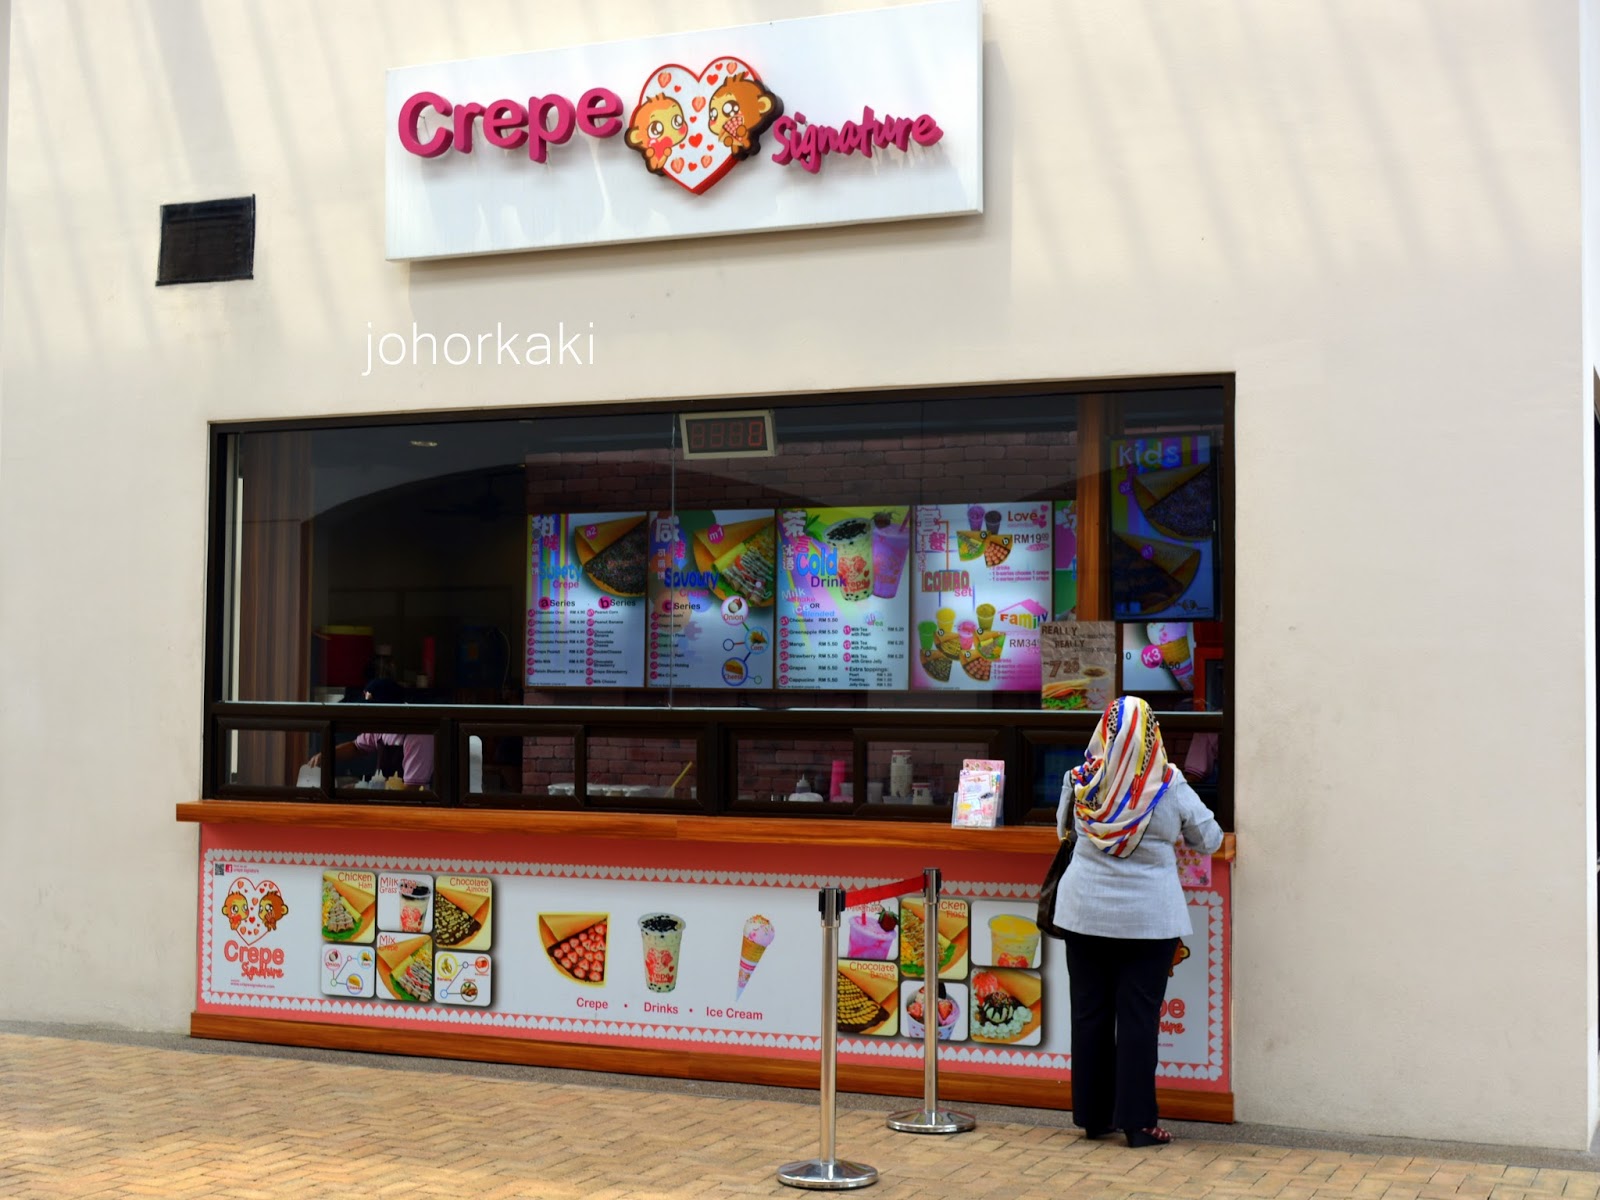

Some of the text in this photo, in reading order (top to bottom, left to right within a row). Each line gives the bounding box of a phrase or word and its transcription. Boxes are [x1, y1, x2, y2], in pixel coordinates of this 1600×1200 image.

[398, 87, 944, 174] Crepe Signature
[1008, 510, 1037, 522] Love
[797, 548, 838, 577] Cold
[664, 567, 720, 590] Savoury
[811, 576, 847, 588] Drink
[553, 580, 580, 589] Crepe
[954, 586, 975, 597] set
[550, 600, 576, 608] Series
[611, 599, 636, 607] Series
[674, 602, 701, 611] Series
[723, 613, 744, 621] Onion
[802, 608, 835, 618] Blended
[1041, 625, 1078, 637] REALLY
[1054, 639, 1085, 649] REALLY
[1143, 647, 1161, 665] K3
[338, 872, 372, 882] Chicken
[450, 877, 489, 887] Chocolate
[380, 878, 416, 888] Milk Tea
[938, 901, 966, 910] icken
[380, 936, 396, 946] Mix
[224, 940, 285, 966] Crepe
[850, 962, 895, 972] Chocolate
[576, 998, 608, 1010] Crepe
[644, 1002, 679, 1014] Drinks
[706, 1006, 763, 1020] Ice Cream
